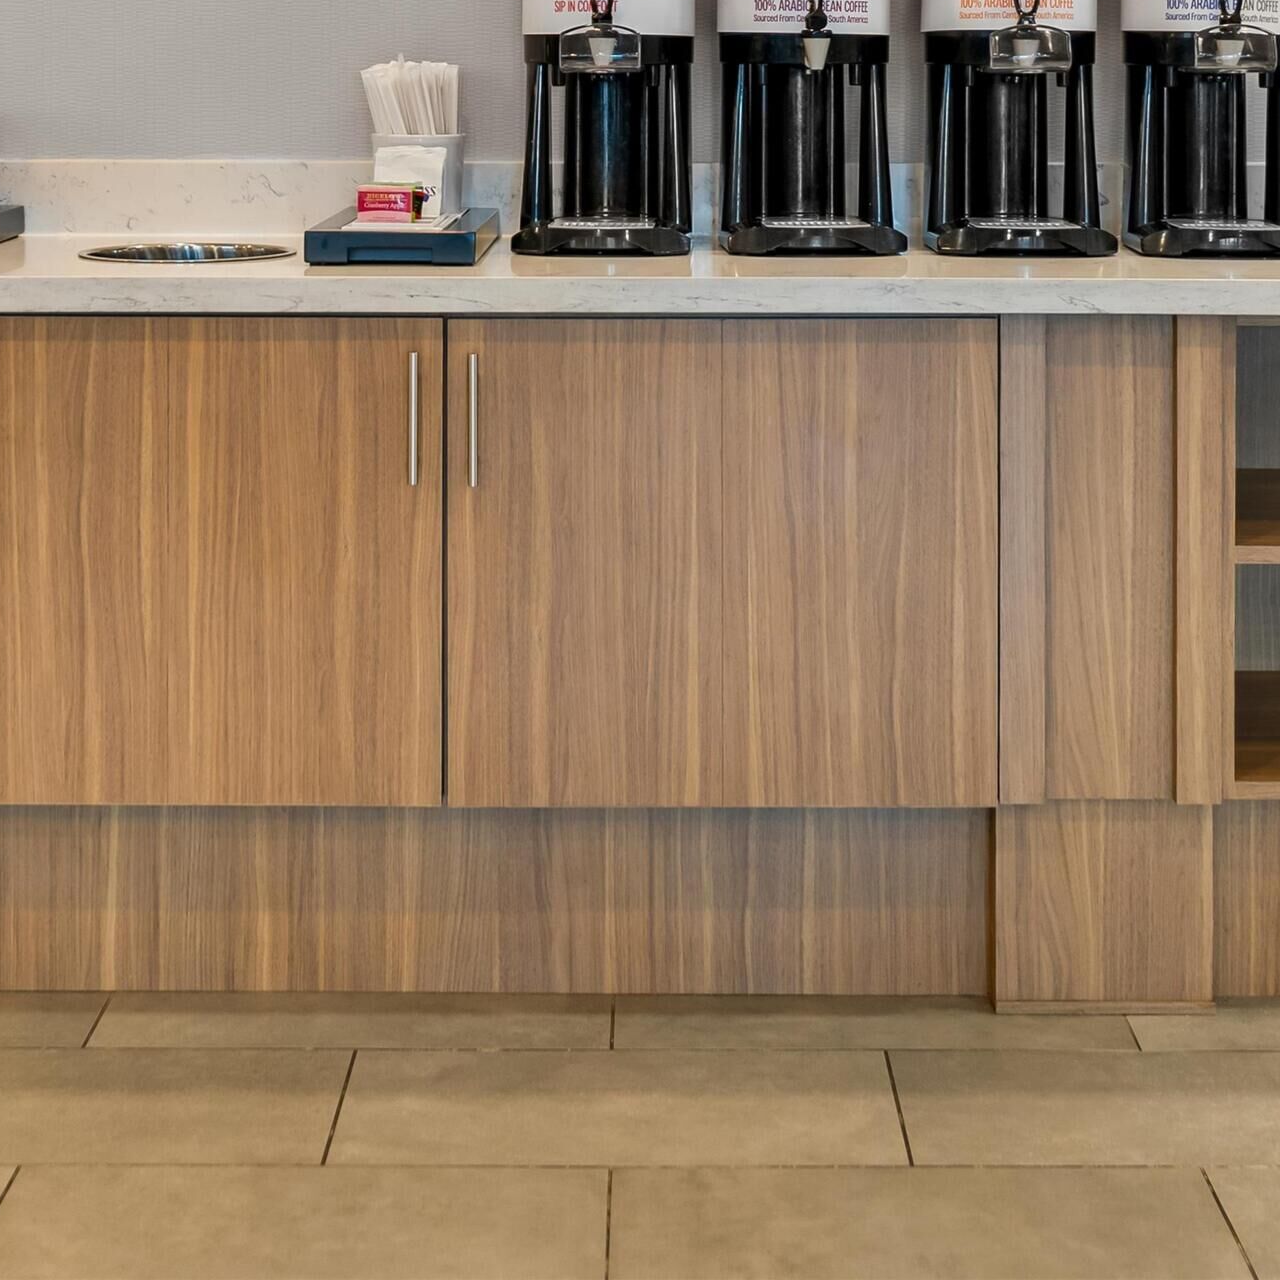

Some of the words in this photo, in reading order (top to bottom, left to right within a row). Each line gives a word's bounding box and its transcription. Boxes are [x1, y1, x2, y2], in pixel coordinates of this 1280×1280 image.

[554, 0, 566, 12] SIP
[568, 0, 576, 12] IN
[754, 0, 777, 11] 100%
[778, 0, 817, 11] ARABIC
[844, 0, 869, 13] COFFEE
[1256, 0, 1279, 13] COFFEE
